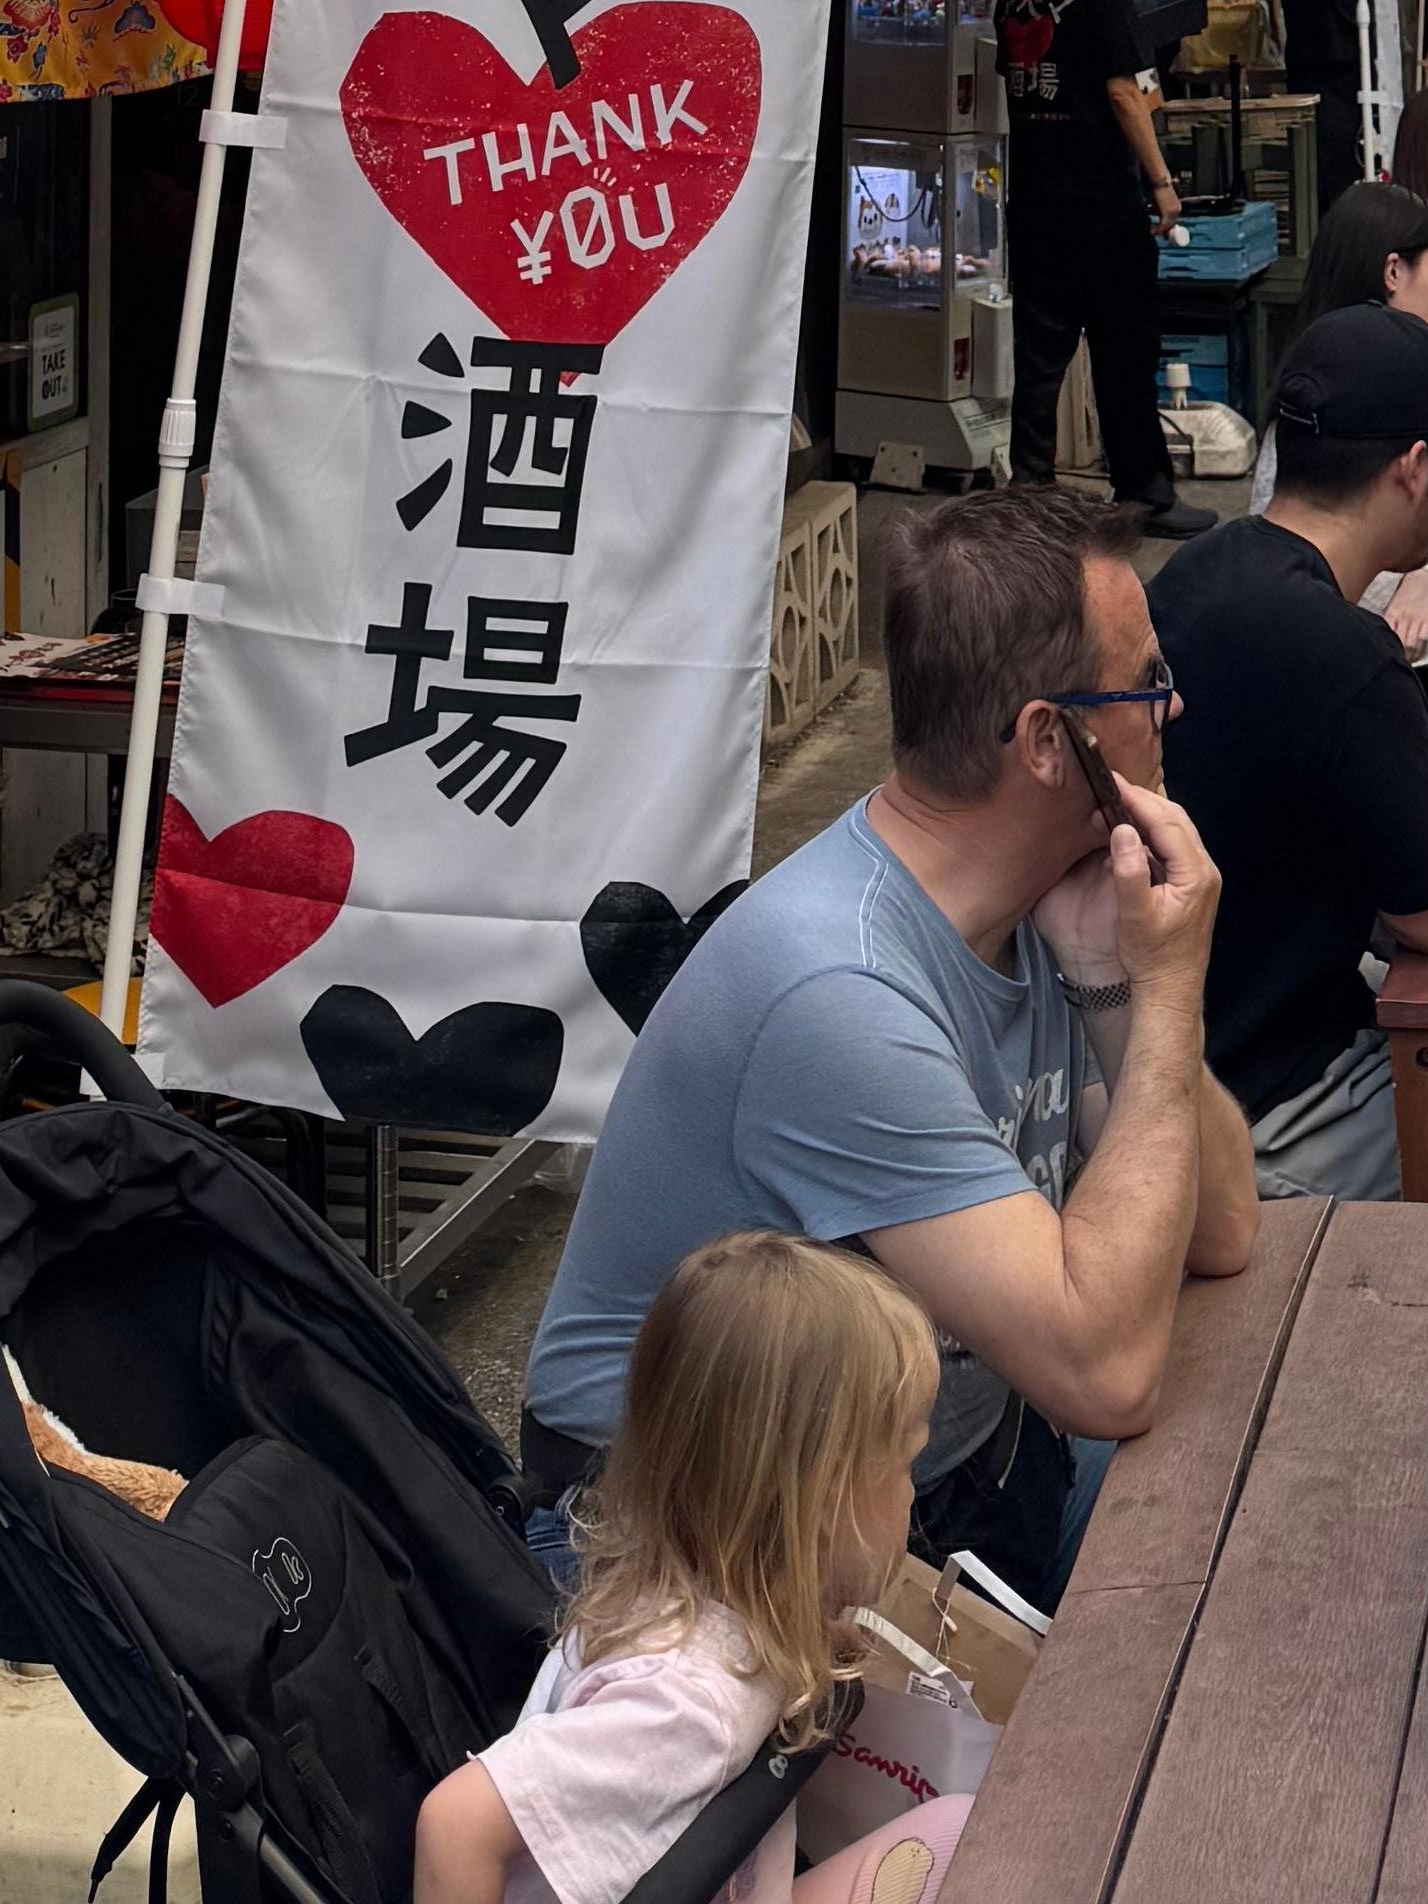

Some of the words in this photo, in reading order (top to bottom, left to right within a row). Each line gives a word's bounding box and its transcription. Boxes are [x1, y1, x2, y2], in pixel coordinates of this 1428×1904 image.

[423, 78, 709, 206] THANK
[42, 348, 65, 375] TAKE
[343, 330, 607, 829] 酒場
